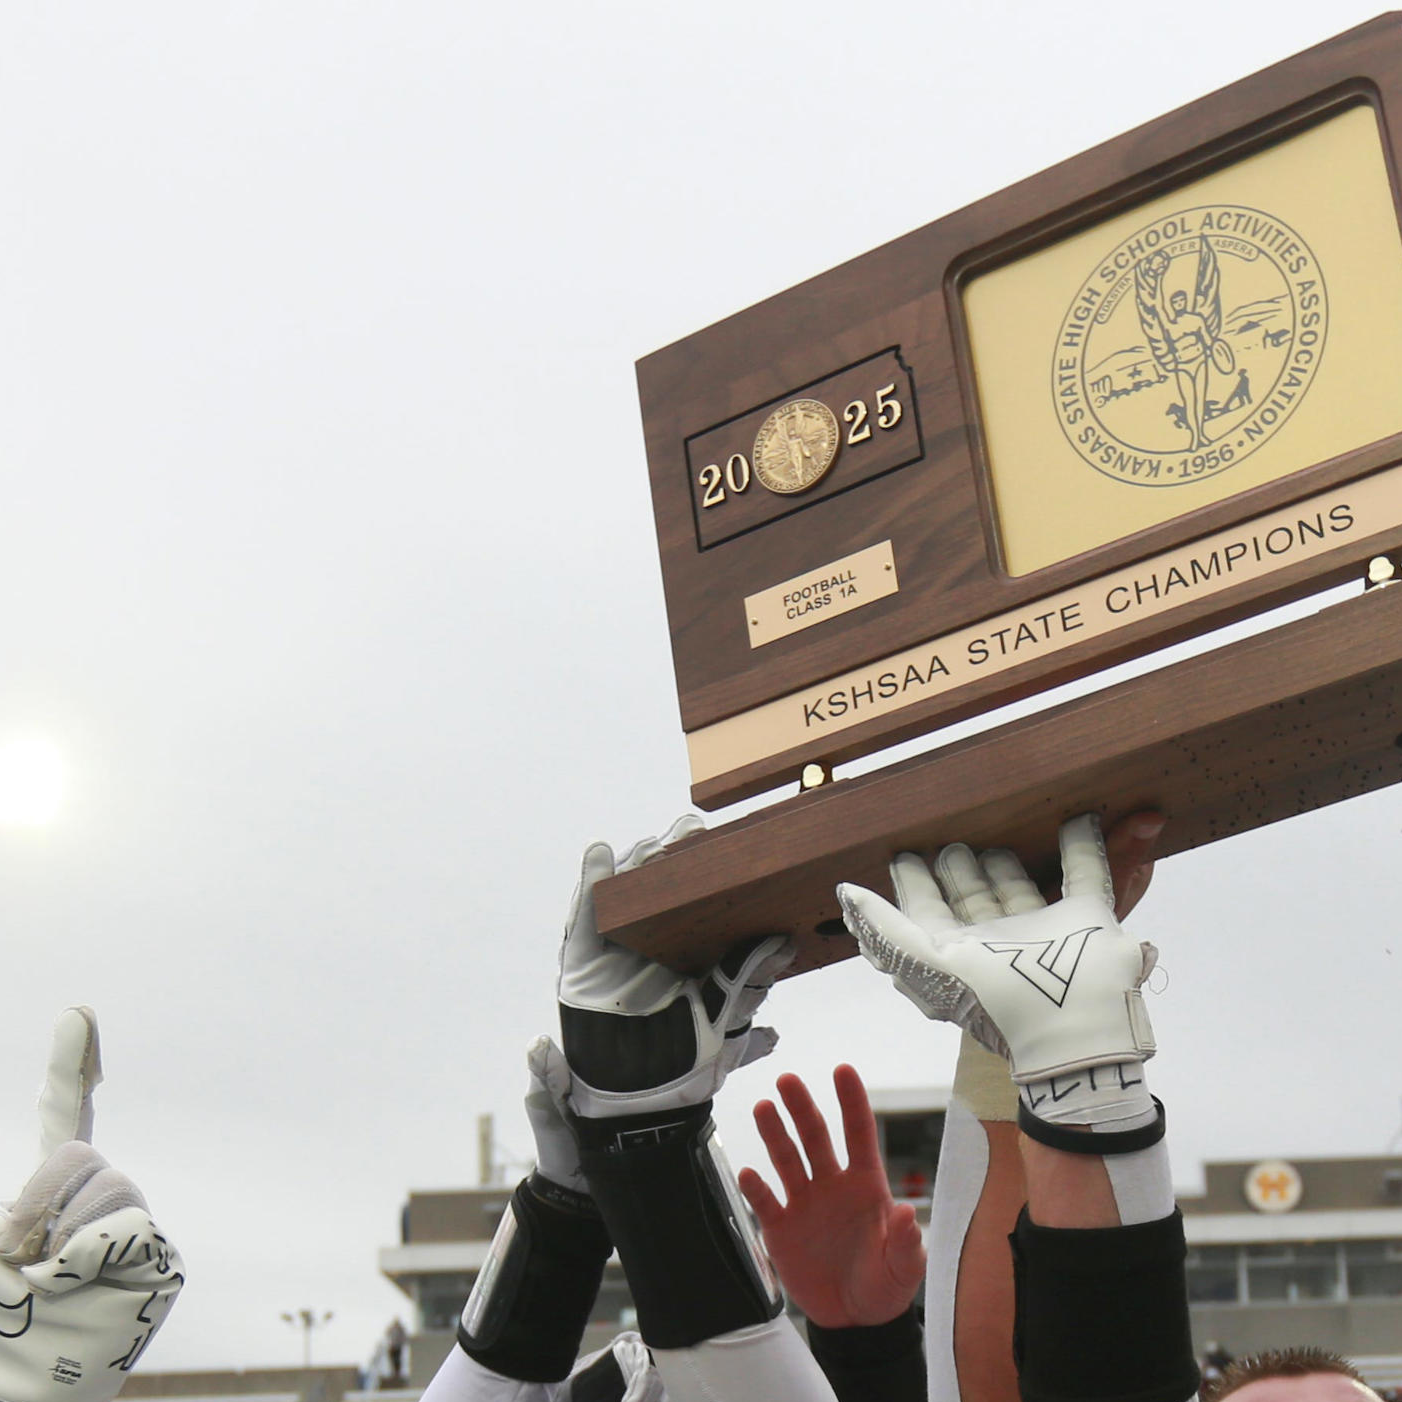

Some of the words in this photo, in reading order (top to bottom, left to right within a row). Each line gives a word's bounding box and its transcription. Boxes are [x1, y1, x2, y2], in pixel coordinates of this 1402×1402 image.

[1099, 217, 1192, 284] SCHOOL
[1171, 241, 1197, 255] PER
[1214, 238, 1254, 258] ASPERA
[1200, 211, 1307, 275] ACTIVITIES
[1063, 287, 1102, 347] HIGH
[1058, 356, 1085, 425] STATE
[1243, 279, 1320, 442] ASSOCIATION
[699, 453, 749, 508] 20
[843, 383, 902, 445] 25
[1078, 425, 1161, 478] KANSAS
[1178, 443, 1234, 478] 1956
[783, 570, 857, 607] FOOTBALL
[786, 596, 833, 620] CLASS
[840, 583, 858, 599] 1A
[802, 655, 951, 728] KSHSAA
[966, 602, 1085, 666] STATE
[1104, 503, 1356, 615] CHAMPIONS
